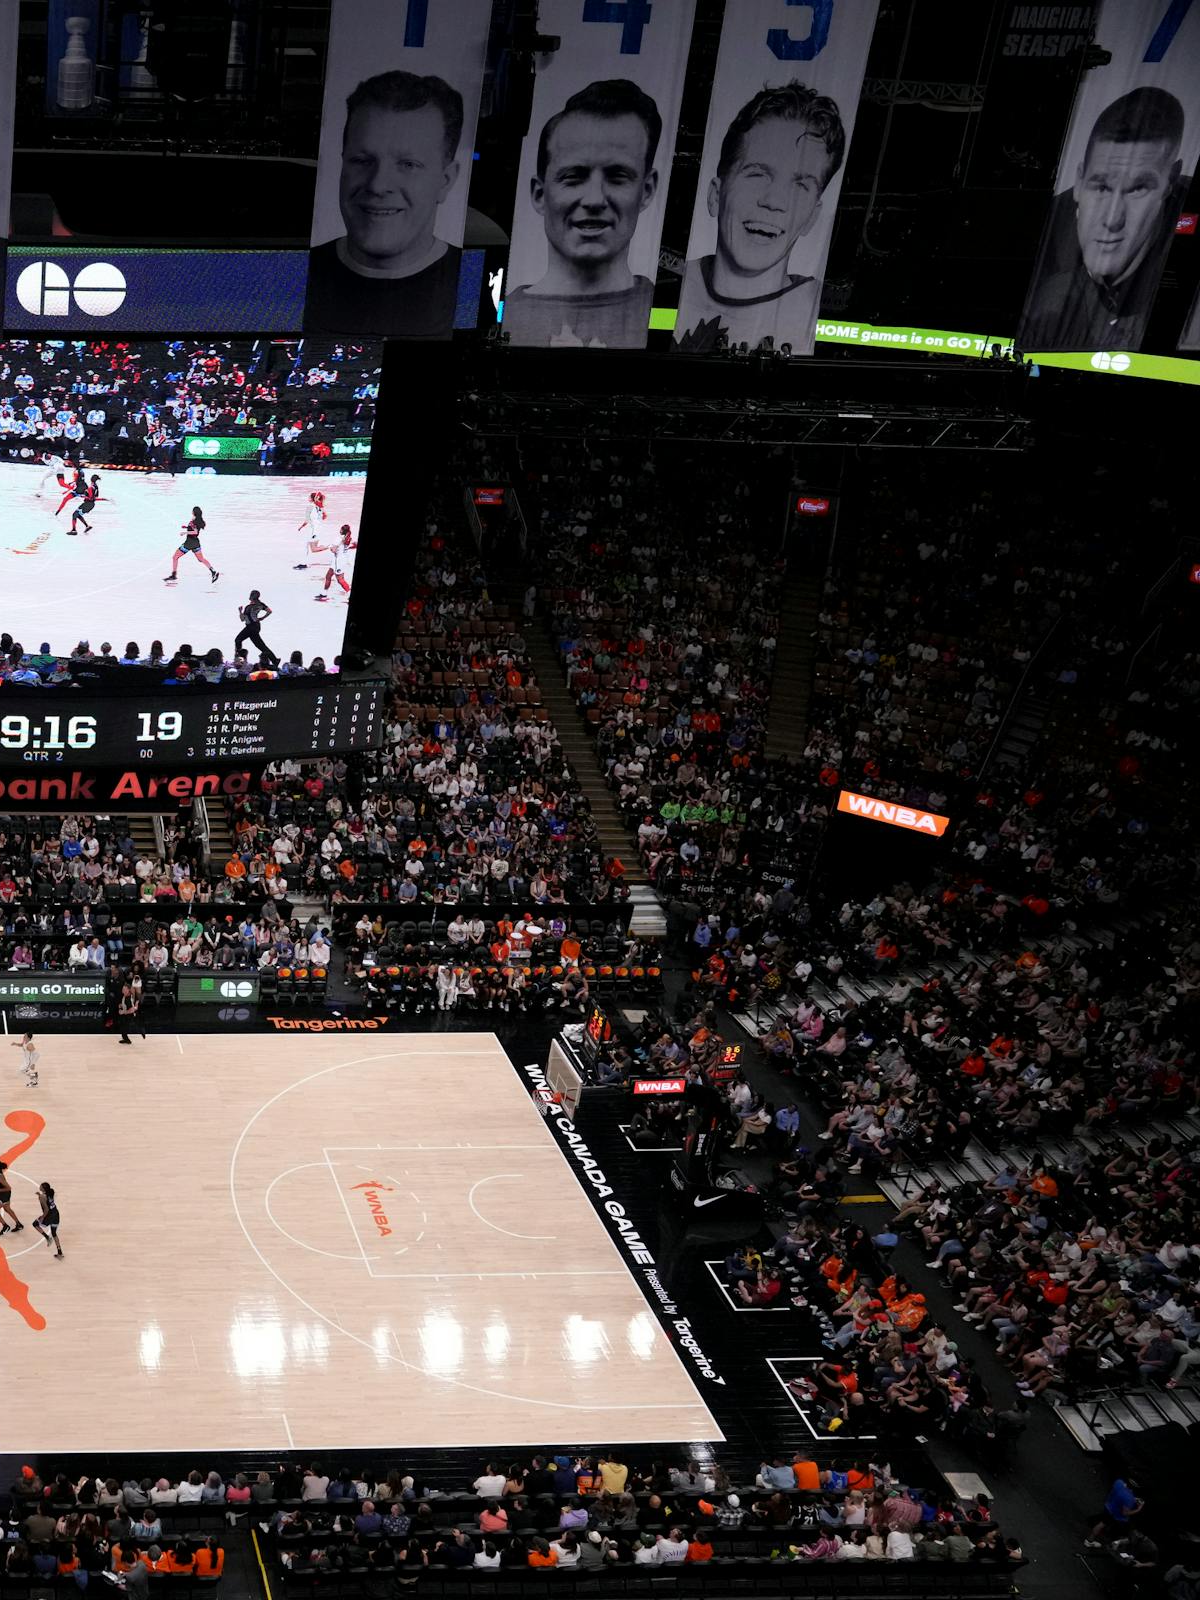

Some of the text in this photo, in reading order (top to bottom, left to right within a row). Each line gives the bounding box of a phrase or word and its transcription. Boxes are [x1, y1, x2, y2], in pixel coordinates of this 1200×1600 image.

[816, 324, 858, 339] HOME
[861, 331, 907, 344] games
[910, 333, 923, 344] is
[925, 336, 943, 346] on
[947, 336, 971, 349] GO
[212, 703, 218, 711] 5
[224, 702, 231, 711] F.
[234, 700, 277, 710] Fitzgerald
[317, 696, 323, 704] 2
[372, 691, 377, 699] 1
[208, 715, 220, 723] 15
[222, 714, 232, 722] A.
[234, 713, 260, 722] Maley
[315, 707, 322, 715] 2
[334, 706, 339, 714] 1
[0, 715, 97, 749] 9:16
[136, 711, 183, 742] 19
[207, 725, 217, 734] 21
[221, 724, 230, 733] R.
[233, 724, 258, 732] Parks
[206, 736, 217, 745] 33
[220, 736, 230, 744] K.
[330, 728, 336, 736] 2
[23, 751, 64, 761] QTR 2
[140, 749, 153, 758] 00
[187, 747, 194, 757] 3
[205, 748, 216, 757] 35
[219, 747, 229, 756] R.
[311, 740, 318, 749] 2
[111, 771, 251, 799] Arena
[848, 796, 938, 832] WNBA
[10, 984, 21, 995] is
[23, 986, 38, 995] on
[41, 984, 62, 995] GO
[64, 983, 105, 995] Transit
[266, 1017, 379, 1032] Tangerine
[637, 1082, 681, 1091] WNBA
[364, 1191, 392, 1236] WNBA
[524, 1063, 716, 1380] WNBA CANADA GAME Presented by Tangerine
